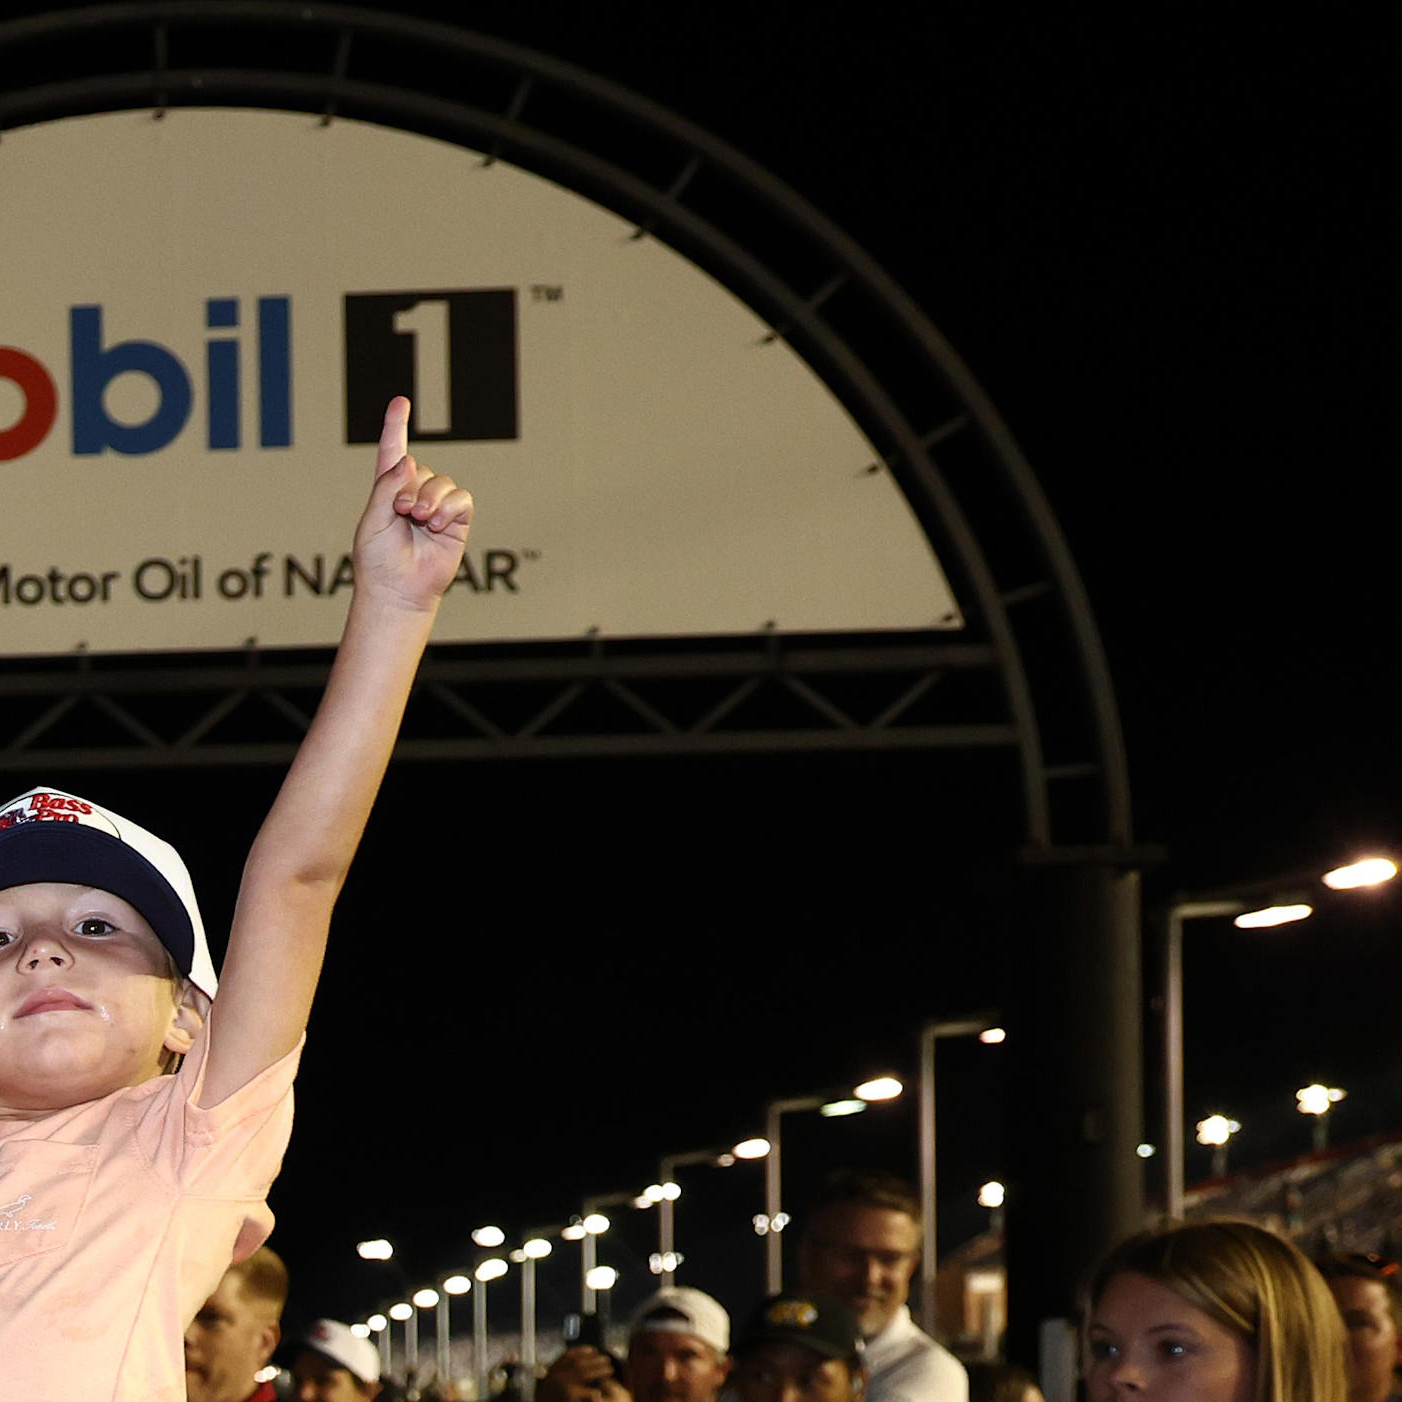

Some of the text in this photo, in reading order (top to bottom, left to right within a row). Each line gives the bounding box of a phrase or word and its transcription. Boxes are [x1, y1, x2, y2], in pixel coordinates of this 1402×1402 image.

[133, 556, 203, 602] Oil
[218, 552, 273, 599] of
[284, 549, 519, 597] NAAR
[28, 794, 93, 815] Bass
